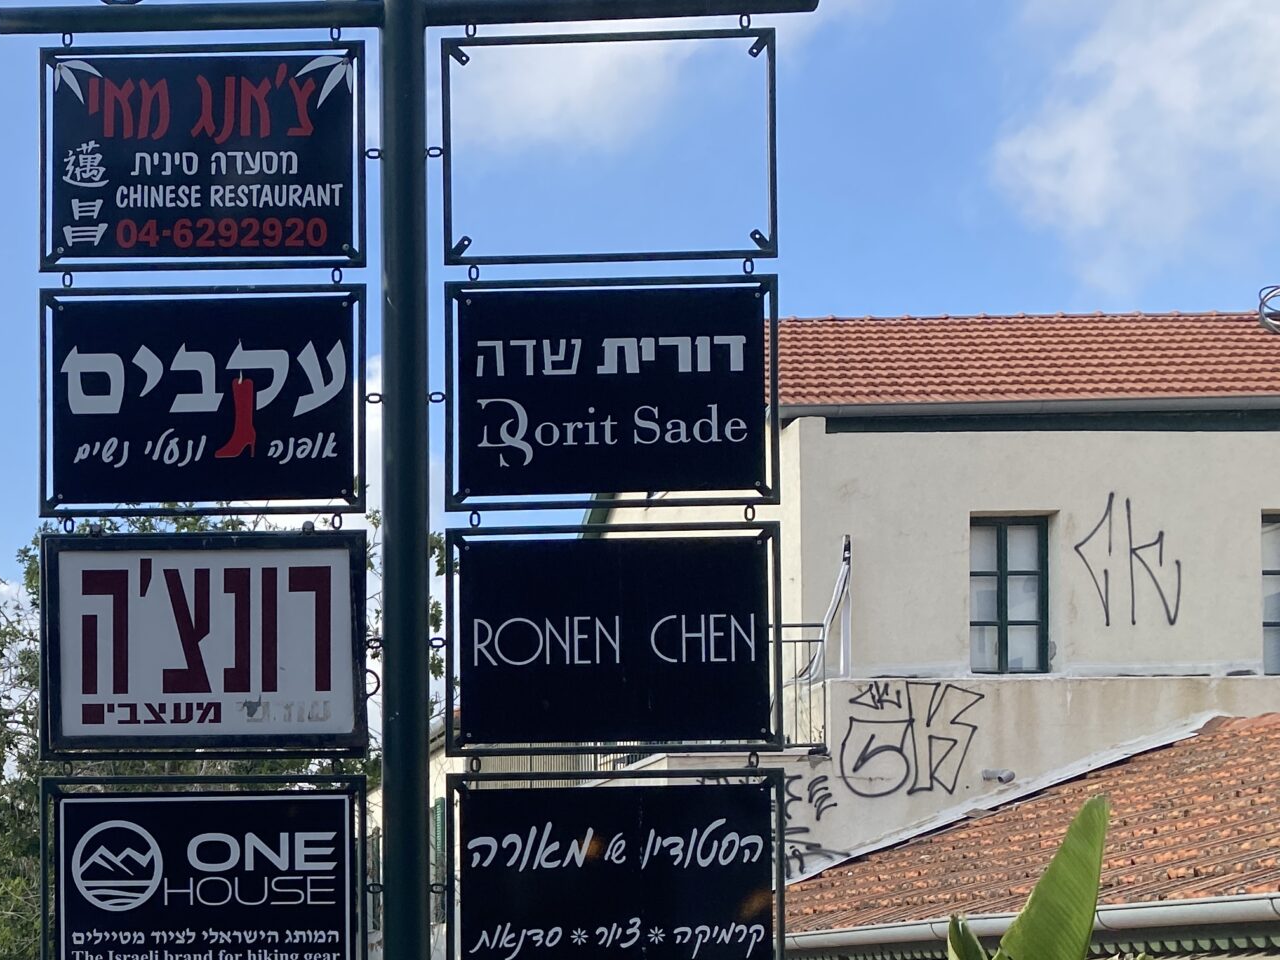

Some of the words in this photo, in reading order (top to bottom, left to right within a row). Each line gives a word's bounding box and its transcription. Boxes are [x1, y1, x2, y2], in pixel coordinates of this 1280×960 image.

[89, 78, 170, 140] מאי
[130, 151, 199, 176] סינית
[210, 150, 298, 176] מסעדה
[115, 183, 202, 208] CHINESE
[210, 183, 344, 208] RESTAURANT
[116, 218, 327, 249] 04-6292920
[476, 338, 582, 377] שדה
[596, 335, 747, 375] דורית
[60, 338, 347, 417] עקבים
[144, 428, 207, 467] ונעלי
[267, 432, 338, 465] אופנה
[476, 398, 618, 467] Dorit
[633, 403, 748, 445] Sade
[73, 437, 130, 468] נשים
[473, 615, 620, 667] RONEN
[650, 613, 756, 663] CHEN
[81, 701, 222, 725] מעצבים
[186, 831, 338, 872] ONE
[467, 821, 594, 873] מאורה
[641, 818, 764, 870] הסטודיו
[164, 875, 336, 906] HOUSE
[71, 929, 145, 945] מטיילים
[150, 927, 196, 945] לציוד
[201, 927, 280, 944] הישראלי
[284, 928, 340, 944] המותג
[468, 922, 563, 960] סדנאות
[595, 917, 642, 949] ציור
[673, 921, 765, 960] קרמיקה
